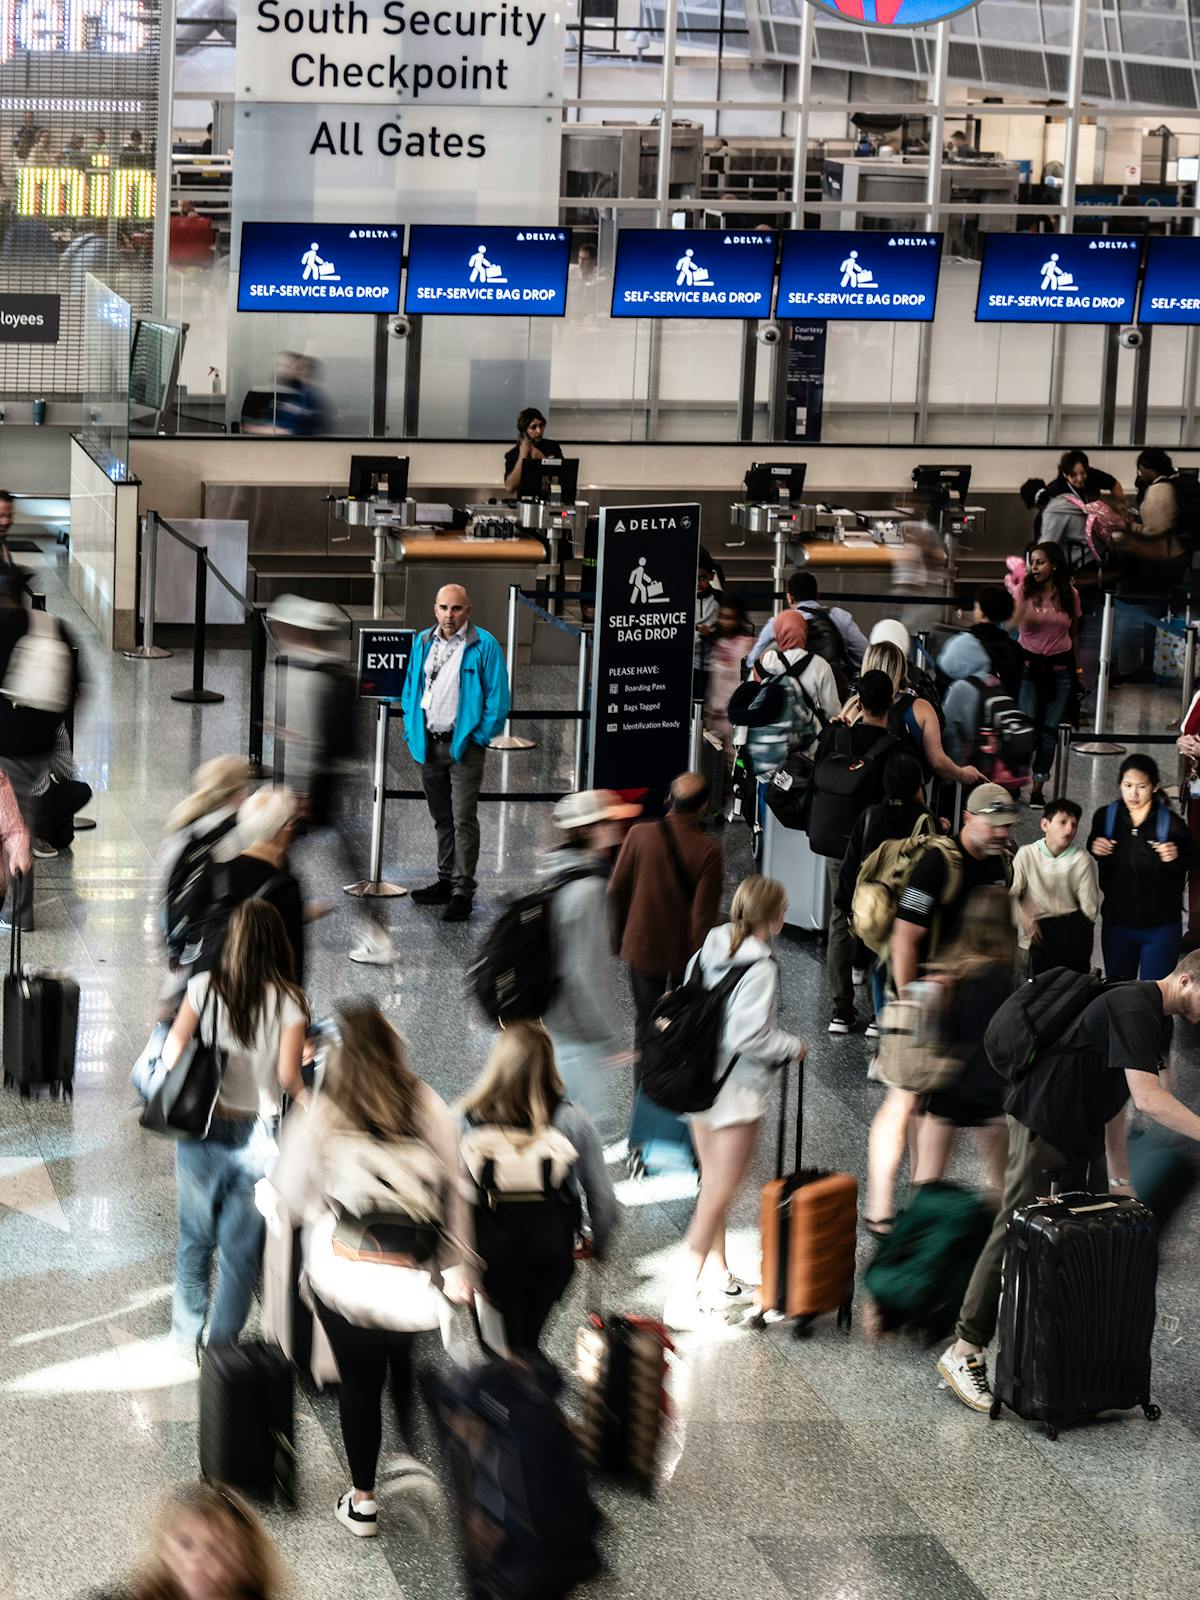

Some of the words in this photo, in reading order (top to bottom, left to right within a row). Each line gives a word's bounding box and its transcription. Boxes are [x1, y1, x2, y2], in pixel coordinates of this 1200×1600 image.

[257, 0, 368, 34] South
[382, 1, 546, 46] Security
[291, 53, 508, 98] Checkpoint
[309, 121, 363, 156] All
[377, 123, 487, 158] Gates
[17, 153, 156, 218] min
[358, 230, 389, 239] DELTA
[526, 233, 556, 241] DELTA
[733, 236, 763, 244] DELTA
[897, 238, 927, 246] DELTA
[1098, 241, 1128, 249] DELTA
[250, 284, 327, 297] SELF-SERVICE
[329, 286, 354, 298] BAG
[356, 286, 389, 298] DROP
[417, 287, 493, 300] SELF-SERVICE
[496, 288, 520, 300] BAG
[523, 289, 556, 301] DROP
[624, 290, 699, 303] SELF-SERVICE
[702, 291, 726, 303] BAG
[729, 292, 761, 304] DROP
[788, 292, 864, 305] SELF-SERVICE
[866, 293, 890, 305] BAG
[893, 294, 926, 306] DROP
[989, 295, 1064, 307] SELF-SERVICE
[1066, 296, 1090, 308] BAG
[1092, 297, 1125, 308] DROP
[794, 326, 824, 335] Courtesy
[794, 334, 815, 342] Phone
[629, 518, 677, 530] DELTA
[609, 612, 687, 628] SELF-SERVICE
[617, 629, 642, 642] BAG
[645, 627, 678, 641] DROP
[367, 653, 407, 669] EXIT
[608, 667, 635, 677] PLEASE
[636, 665, 660, 675] HAVE:
[624, 684, 651, 692] Boarding
[623, 703, 638, 712] Bags
[639, 702, 661, 711] Tagged
[622, 722, 660, 730] Identification
[661, 720, 680, 729] Ready
